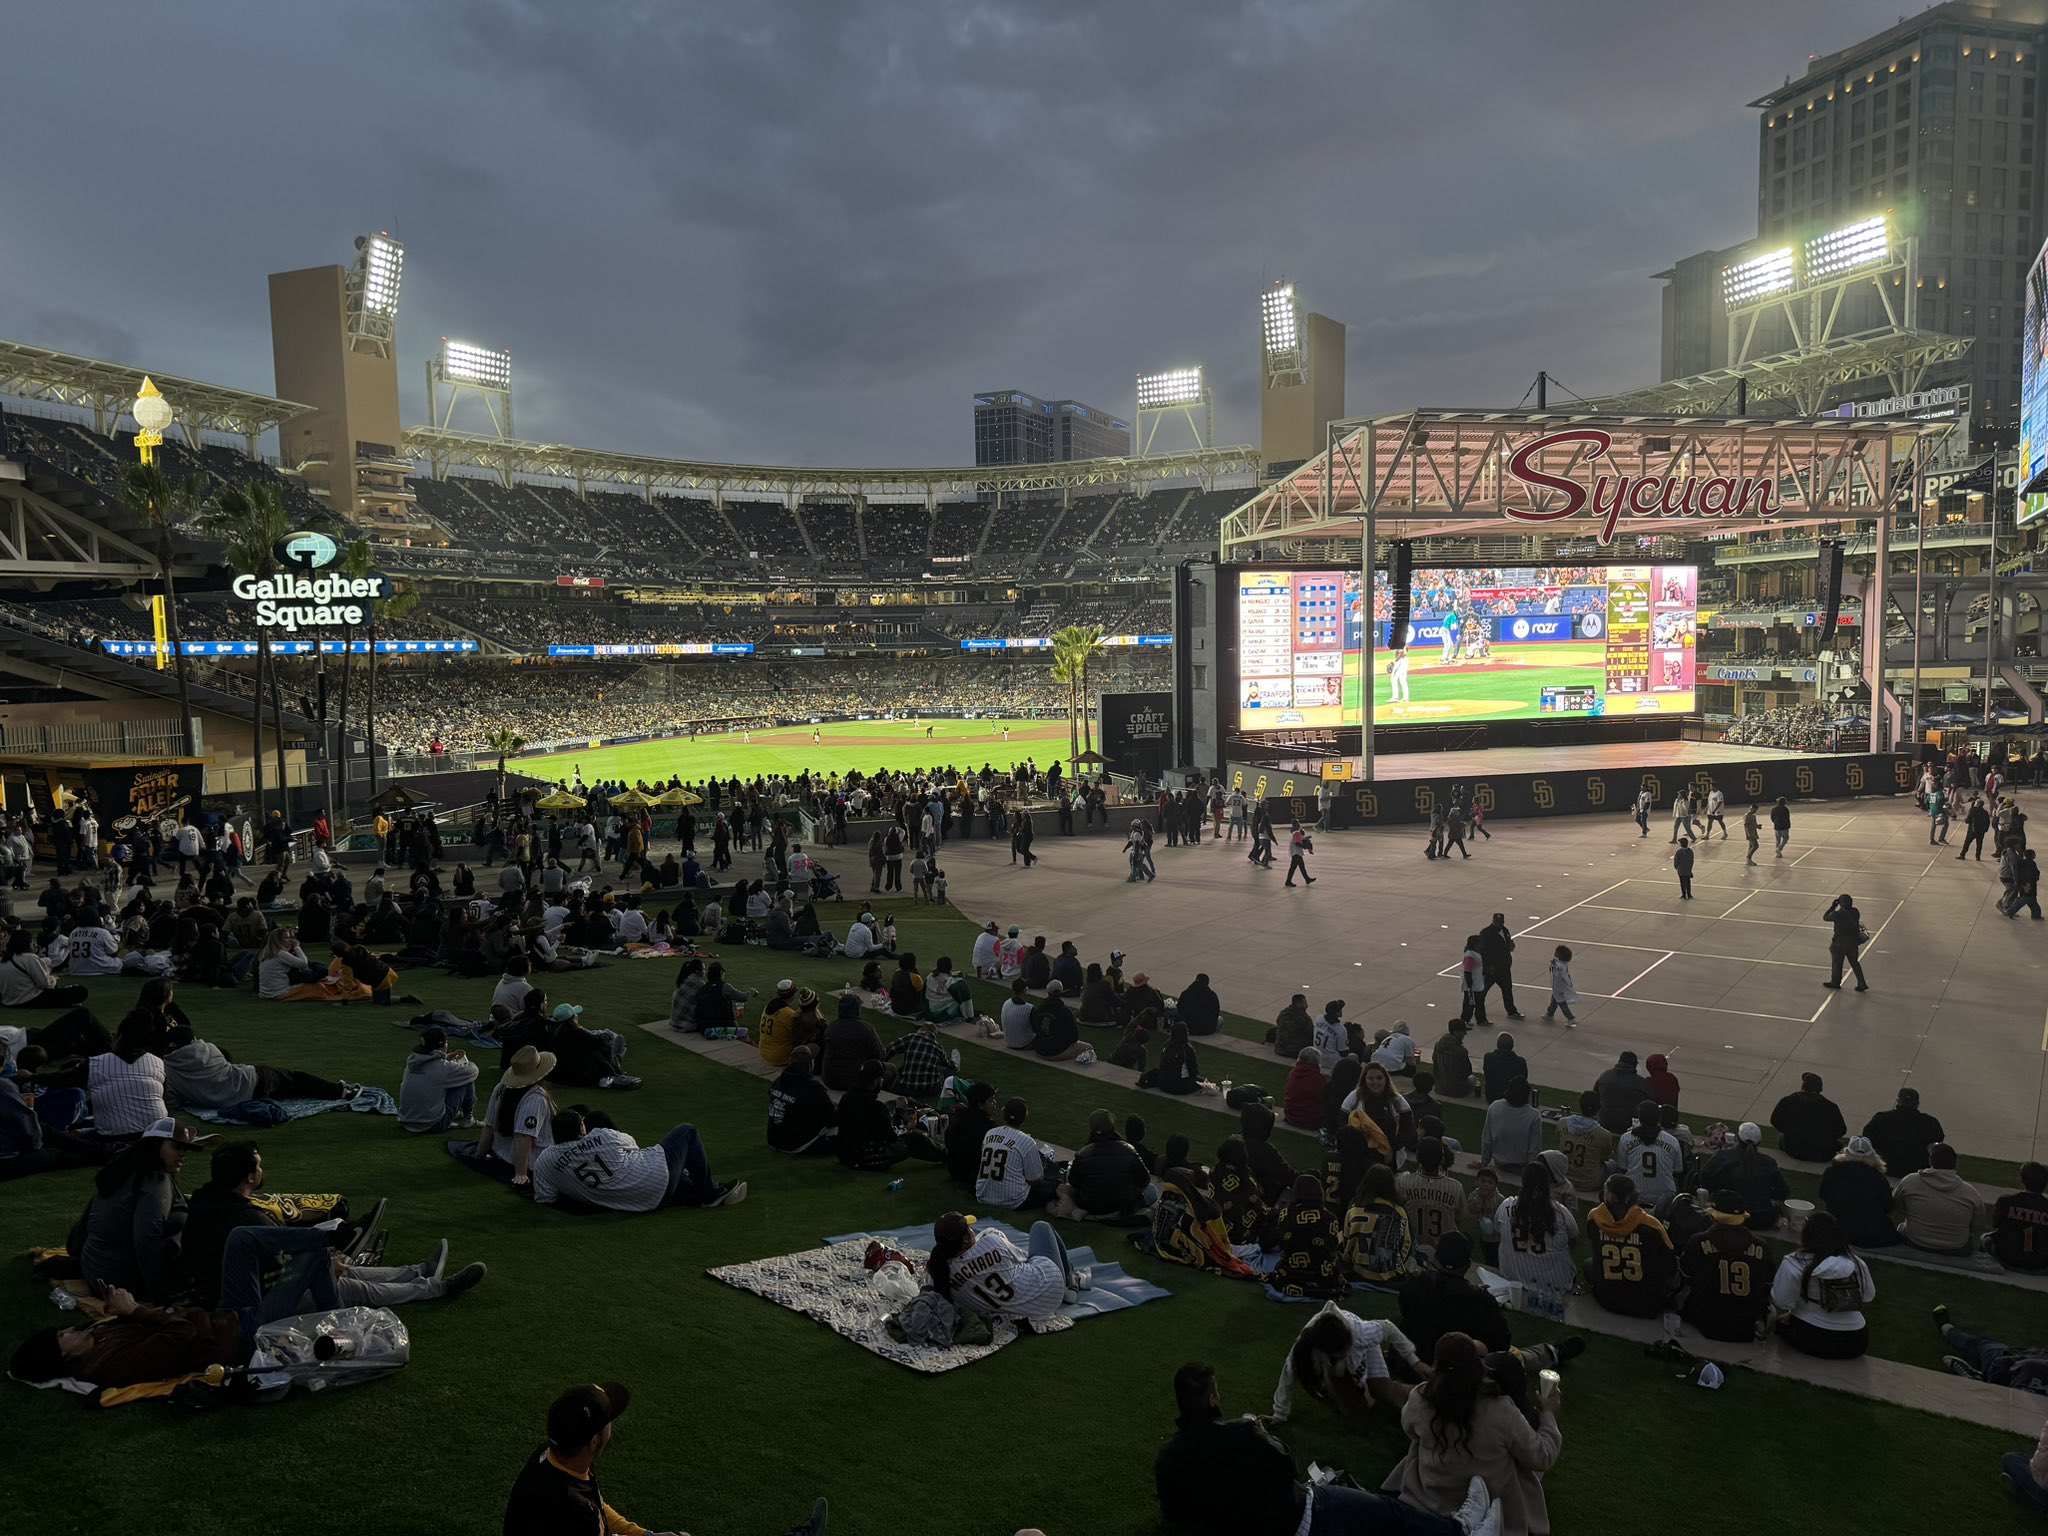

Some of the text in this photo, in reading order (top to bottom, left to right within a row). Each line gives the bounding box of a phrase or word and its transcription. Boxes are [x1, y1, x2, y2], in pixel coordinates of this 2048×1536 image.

[1857, 387, 1960, 418] QuidelOrtho
[1504, 429, 1784, 547] Sycuan
[232, 573, 382, 604] Gallagher
[256, 600, 363, 632] Square
[1531, 622, 1559, 634] razr
[1717, 667, 1758, 680] Canel's
[1130, 712, 1165, 724] CRAFT
[1136, 722, 1161, 734] PIER
[72, 941, 91, 959] 23
[553, 1135, 602, 1173] HOFFMAN
[985, 1134, 1005, 1144] TATIS
[1563, 1140, 1587, 1167] 23
[573, 1154, 613, 1189] 51
[979, 1147, 1008, 1182] 23
[1642, 1151, 1657, 1178] 9
[1404, 1188, 1455, 1206] MACHADO
[1416, 1206, 1441, 1240] 13
[2023, 1226, 2033, 1253] 1
[949, 1249, 1002, 1291] MACHADO
[1601, 1244, 1643, 1282] 23
[1718, 1259, 1751, 1297] 13
[972, 1272, 1013, 1309] 13
